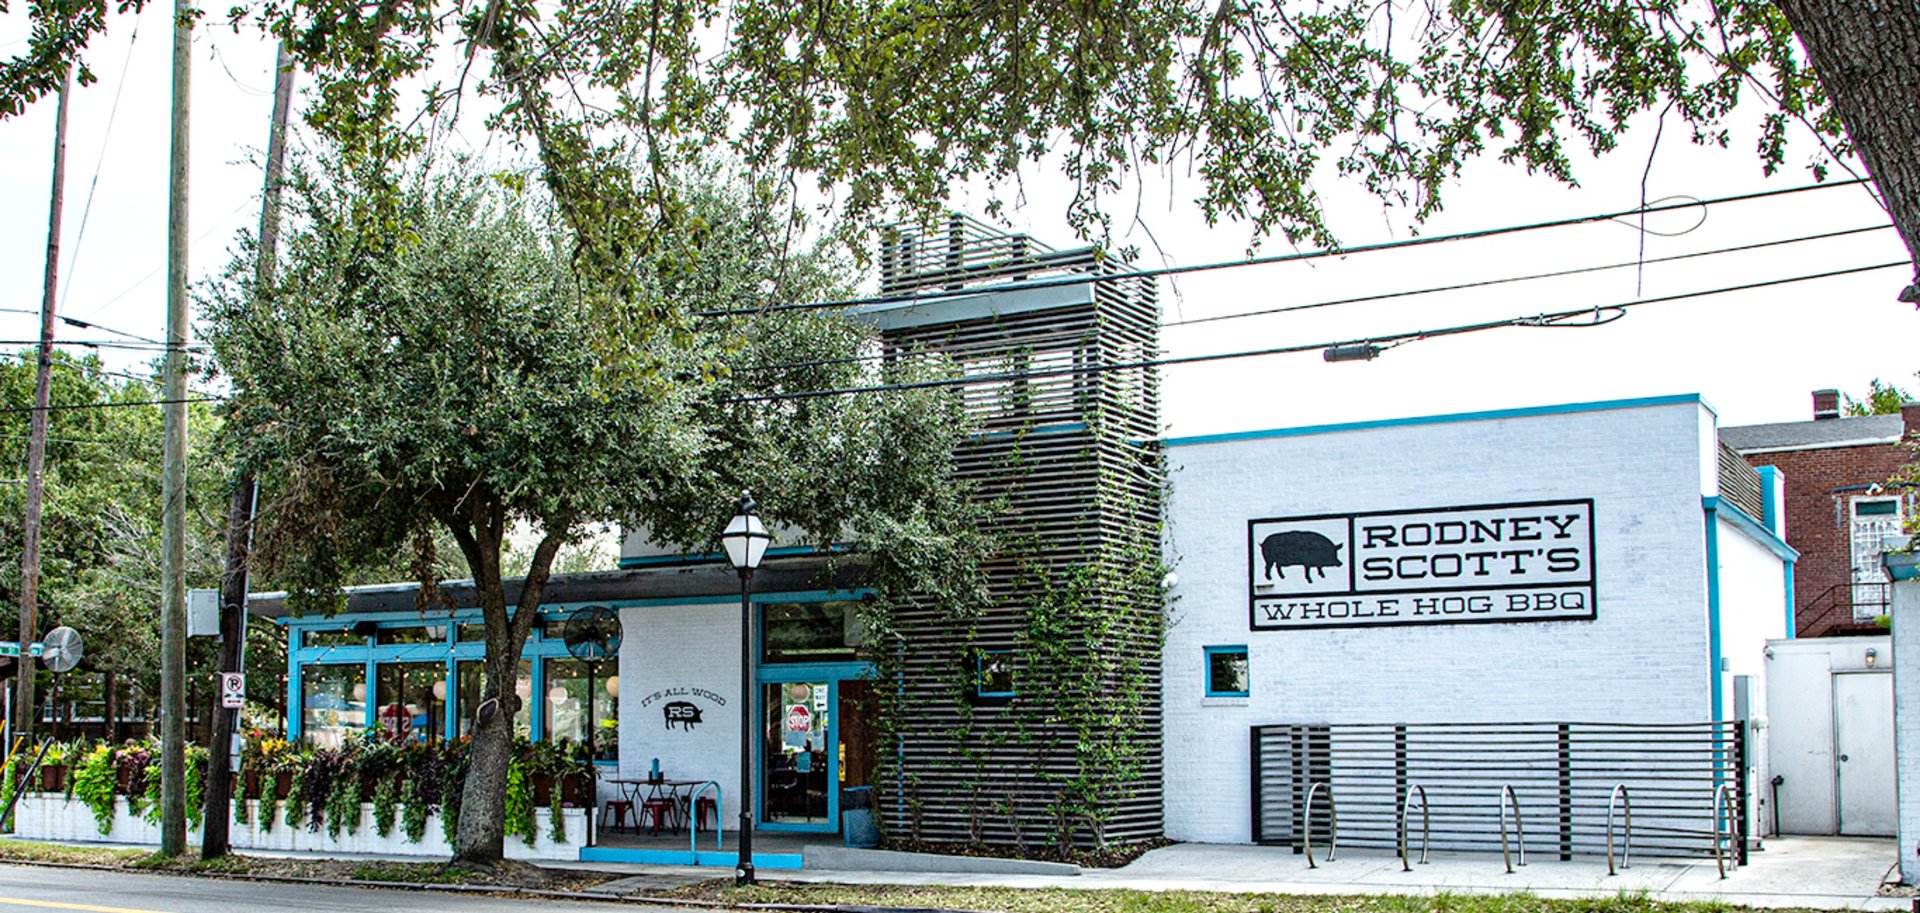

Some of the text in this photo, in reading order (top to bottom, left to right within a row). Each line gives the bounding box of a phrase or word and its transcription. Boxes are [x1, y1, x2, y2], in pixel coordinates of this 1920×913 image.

[1362, 514, 1580, 548] RODNEY
[1363, 547, 1580, 581] SCOTT'S
[1261, 592, 1585, 620] WHOLE HOG BBQ
[664, 687, 689, 697] ALL
[692, 687, 726, 706] WOOD
[668, 706, 694, 718] RS
[789, 715, 809, 728] STOP
